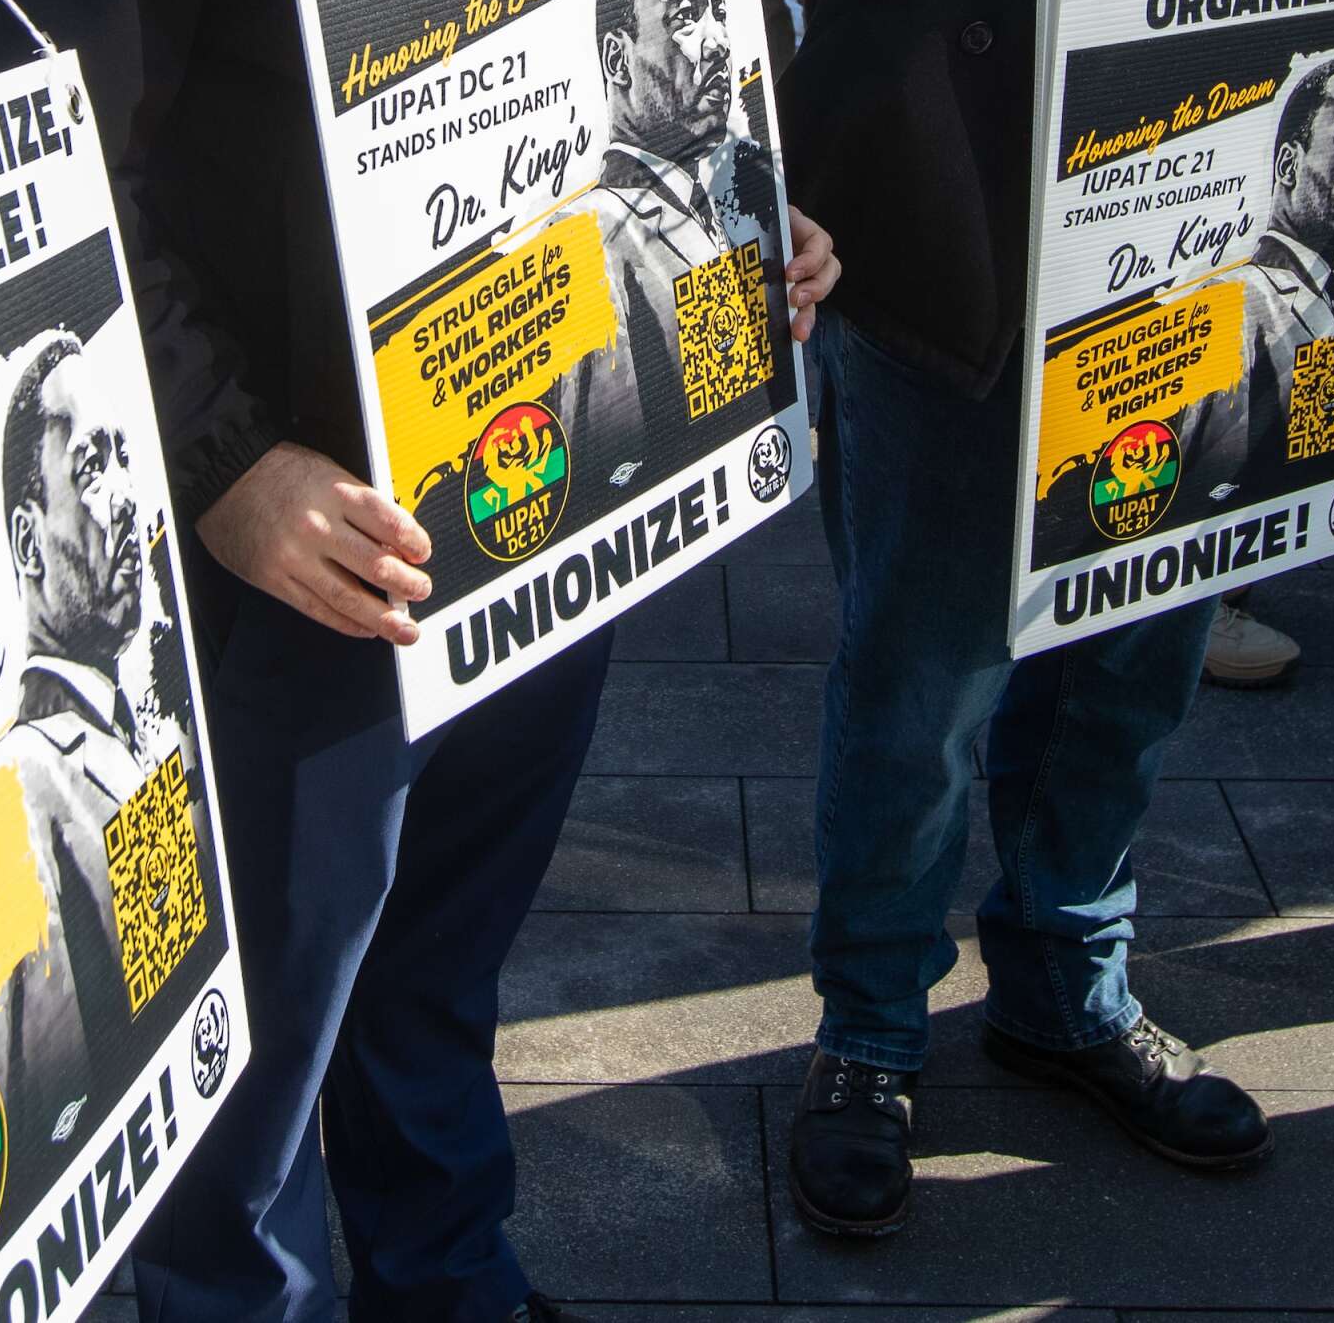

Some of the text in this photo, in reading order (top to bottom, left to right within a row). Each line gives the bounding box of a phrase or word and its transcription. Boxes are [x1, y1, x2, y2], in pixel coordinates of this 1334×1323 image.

[342, 19, 460, 104] Honoring
[370, 50, 526, 130] IUPAT DC 21
[356, 79, 572, 174] STANDS IN SOLIDARITY
[1066, 77, 1277, 173] Honoring the Dream
[426, 105, 591, 250] Dr. King's
[1064, 176, 1246, 228] STANDS IN SOLIDARITY
[1082, 148, 1214, 196] IUPAT DC 21
[1107, 197, 1255, 293] Dr. King's
[413, 243, 563, 354] STRUGGLE for
[420, 263, 571, 381] CIVIL RIGHTS
[1076, 301, 1210, 368] STRUGGLE for
[431, 295, 570, 407] & WORKERS'
[466, 340, 552, 419] RIGHTS
[1076, 319, 1212, 391] CIVIL RIGHTS
[1081, 346, 1207, 412] & WORKERS'
[1106, 377, 1184, 425] RIGHTS
[494, 492, 552, 544] IUPAT
[507, 524, 545, 557] DC 21
[1108, 497, 1157, 524] IUPAT
[1116, 515, 1149, 536] DC 21
[445, 466, 731, 686] UNIONIZE!
[1053, 502, 1310, 626] UNIONIZE!
